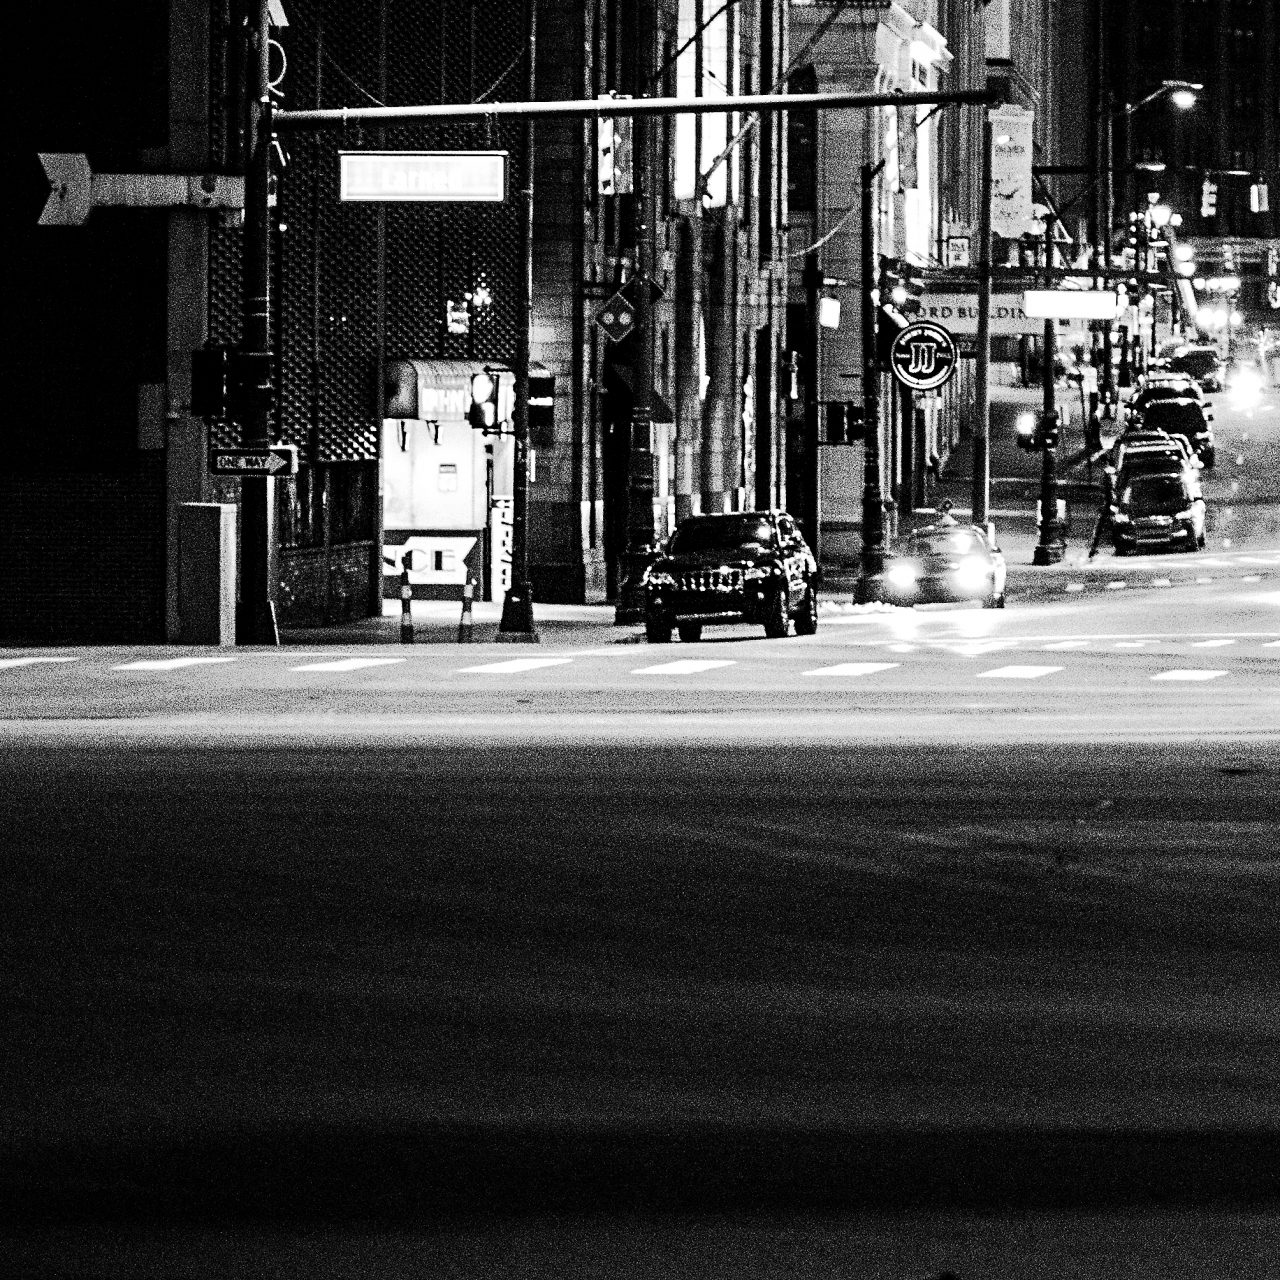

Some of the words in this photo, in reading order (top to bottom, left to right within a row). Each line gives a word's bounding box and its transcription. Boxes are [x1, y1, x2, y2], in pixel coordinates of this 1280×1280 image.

[916, 306, 953, 319] ORD
[219, 455, 241, 469] ONE
[245, 455, 268, 469] WAY
